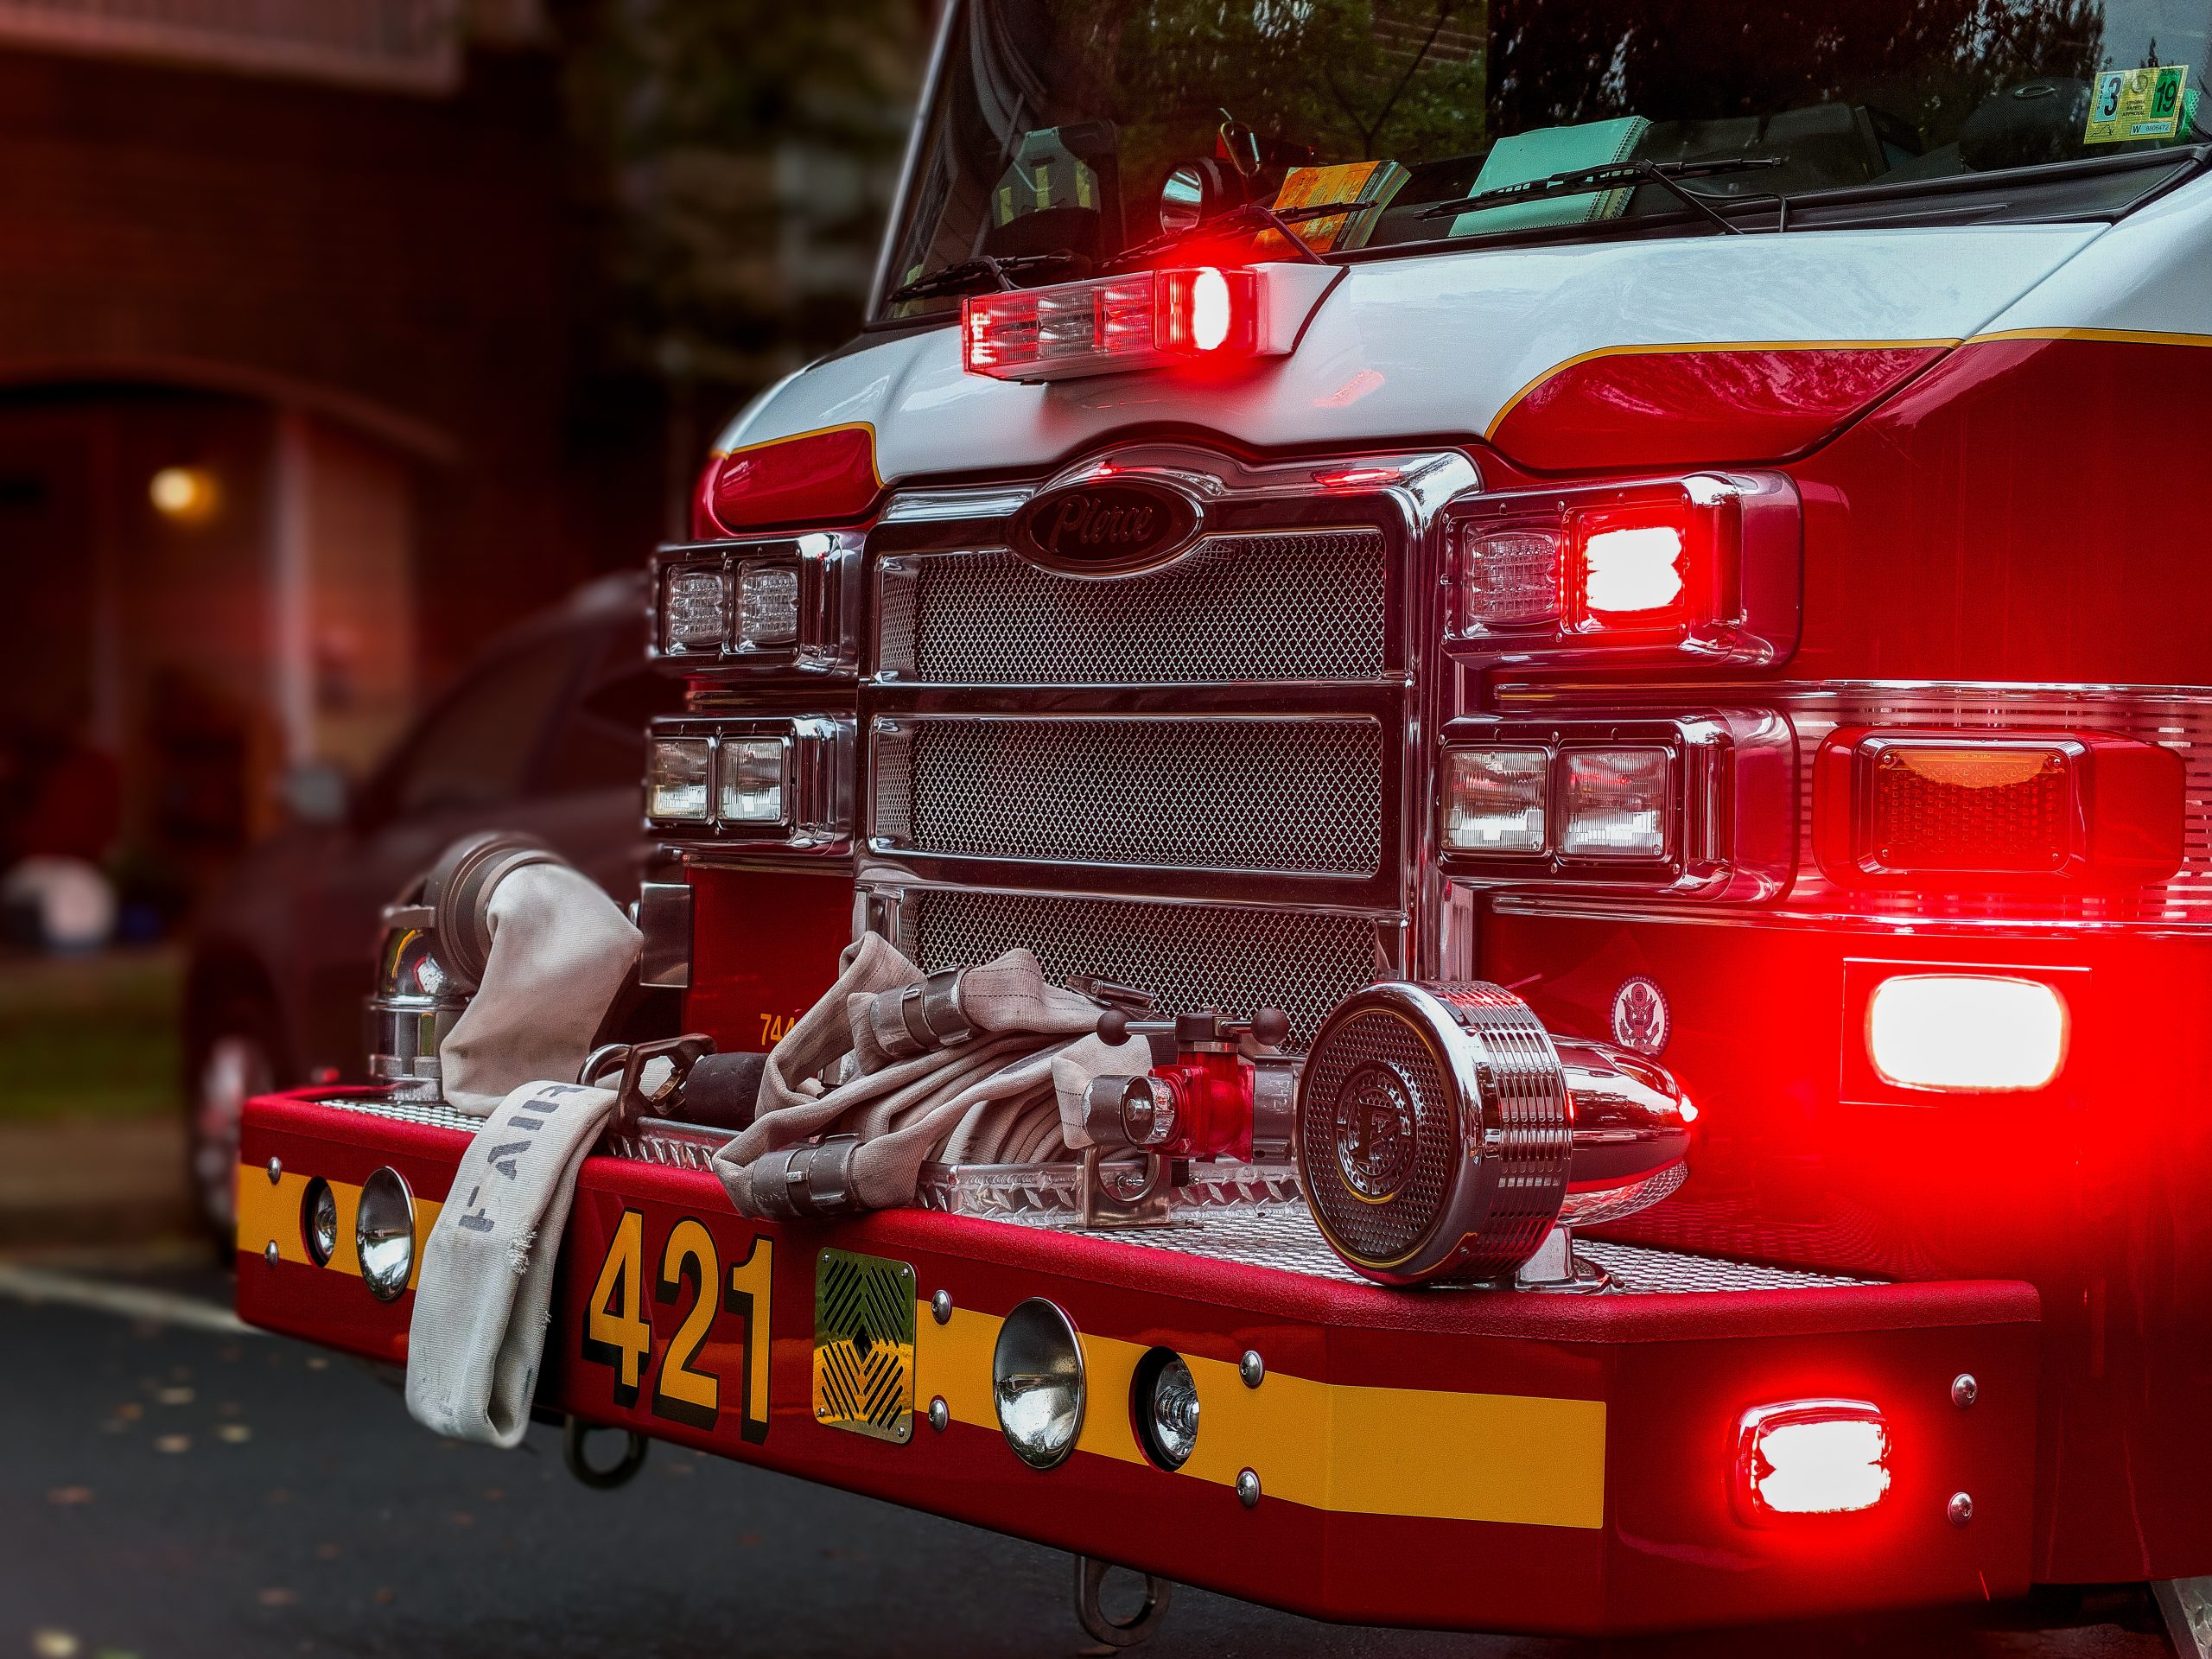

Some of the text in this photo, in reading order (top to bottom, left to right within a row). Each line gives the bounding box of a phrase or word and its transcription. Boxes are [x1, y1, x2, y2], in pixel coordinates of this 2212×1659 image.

[2104, 77, 2121, 116] 3
[2156, 79, 2177, 113] 19
[1048, 493, 1154, 554] Pierce
[585, 1209, 773, 1436] 421
